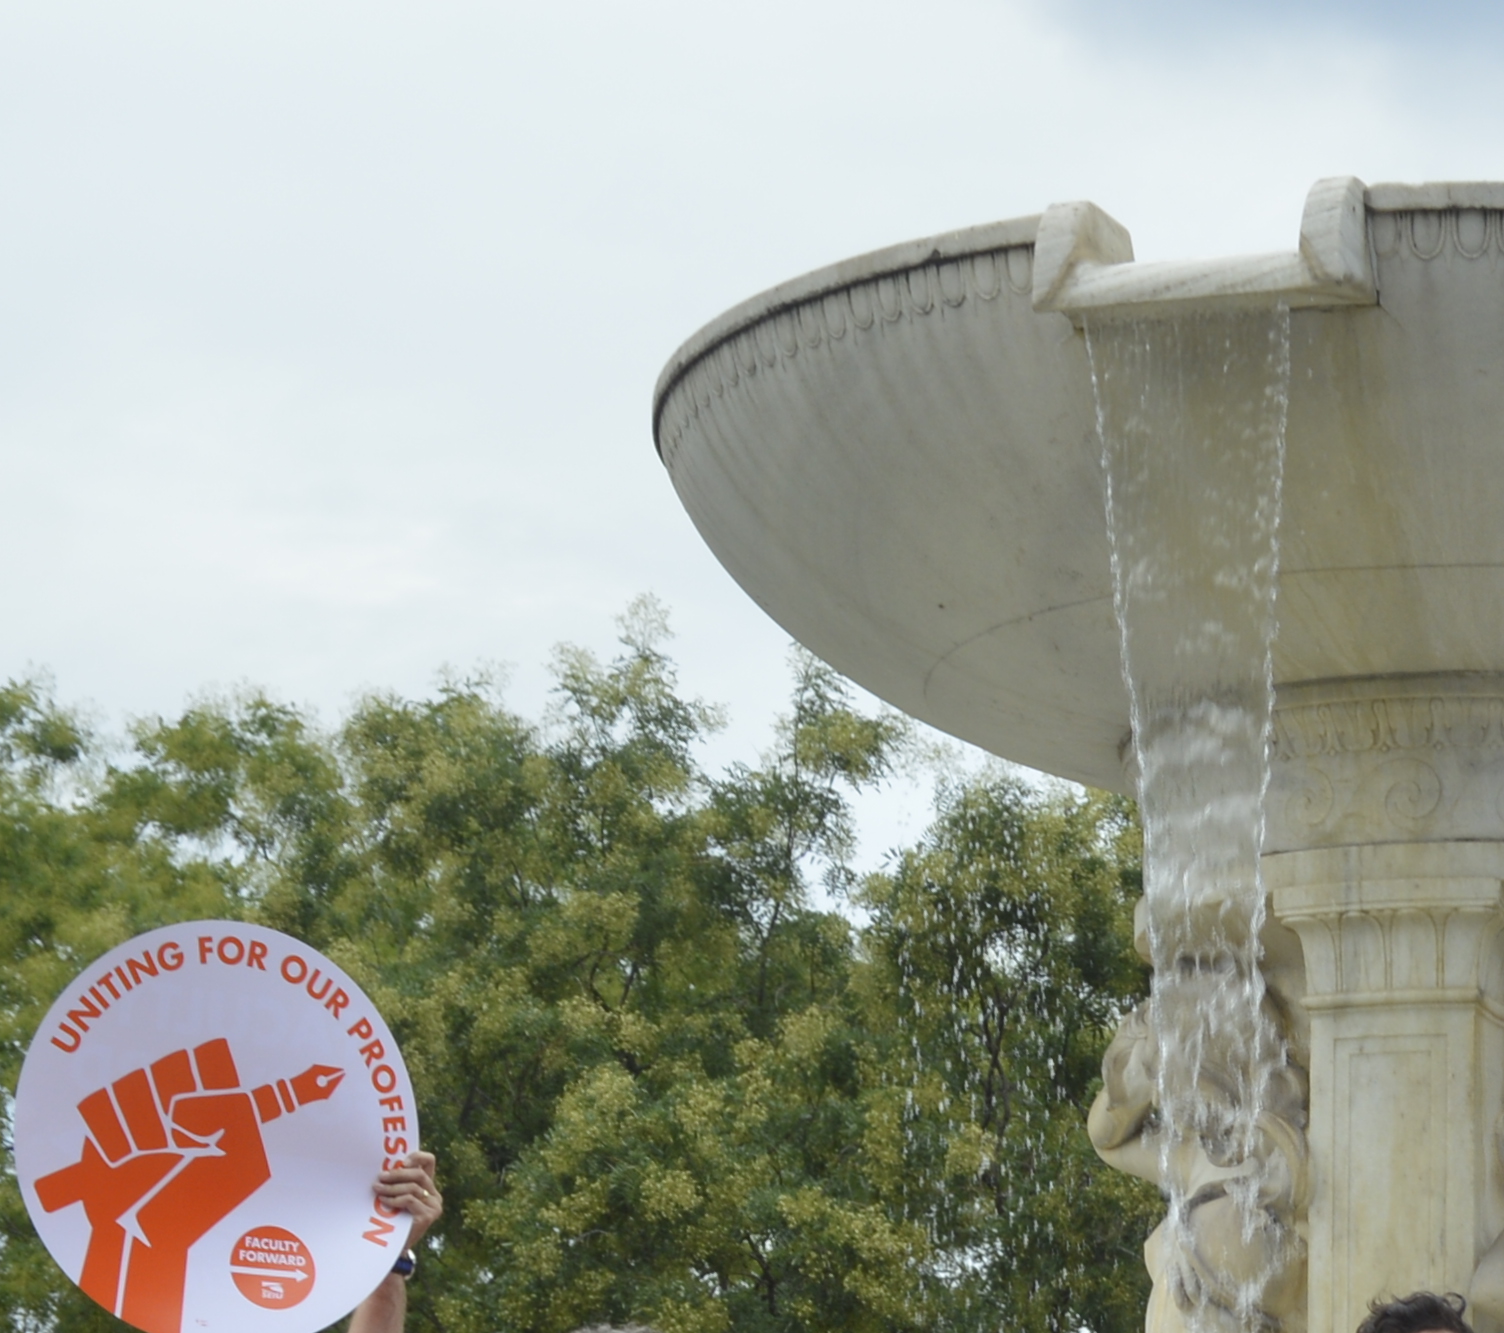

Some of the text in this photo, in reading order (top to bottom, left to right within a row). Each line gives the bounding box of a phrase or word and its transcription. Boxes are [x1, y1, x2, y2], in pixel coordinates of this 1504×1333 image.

[50, 941, 185, 1053] UNITING
[197, 936, 268, 970] FOR
[280, 955, 350, 1020] OUR
[245, 1236, 299, 1252] FACULTY
[239, 1249, 306, 1267] FORWARD
